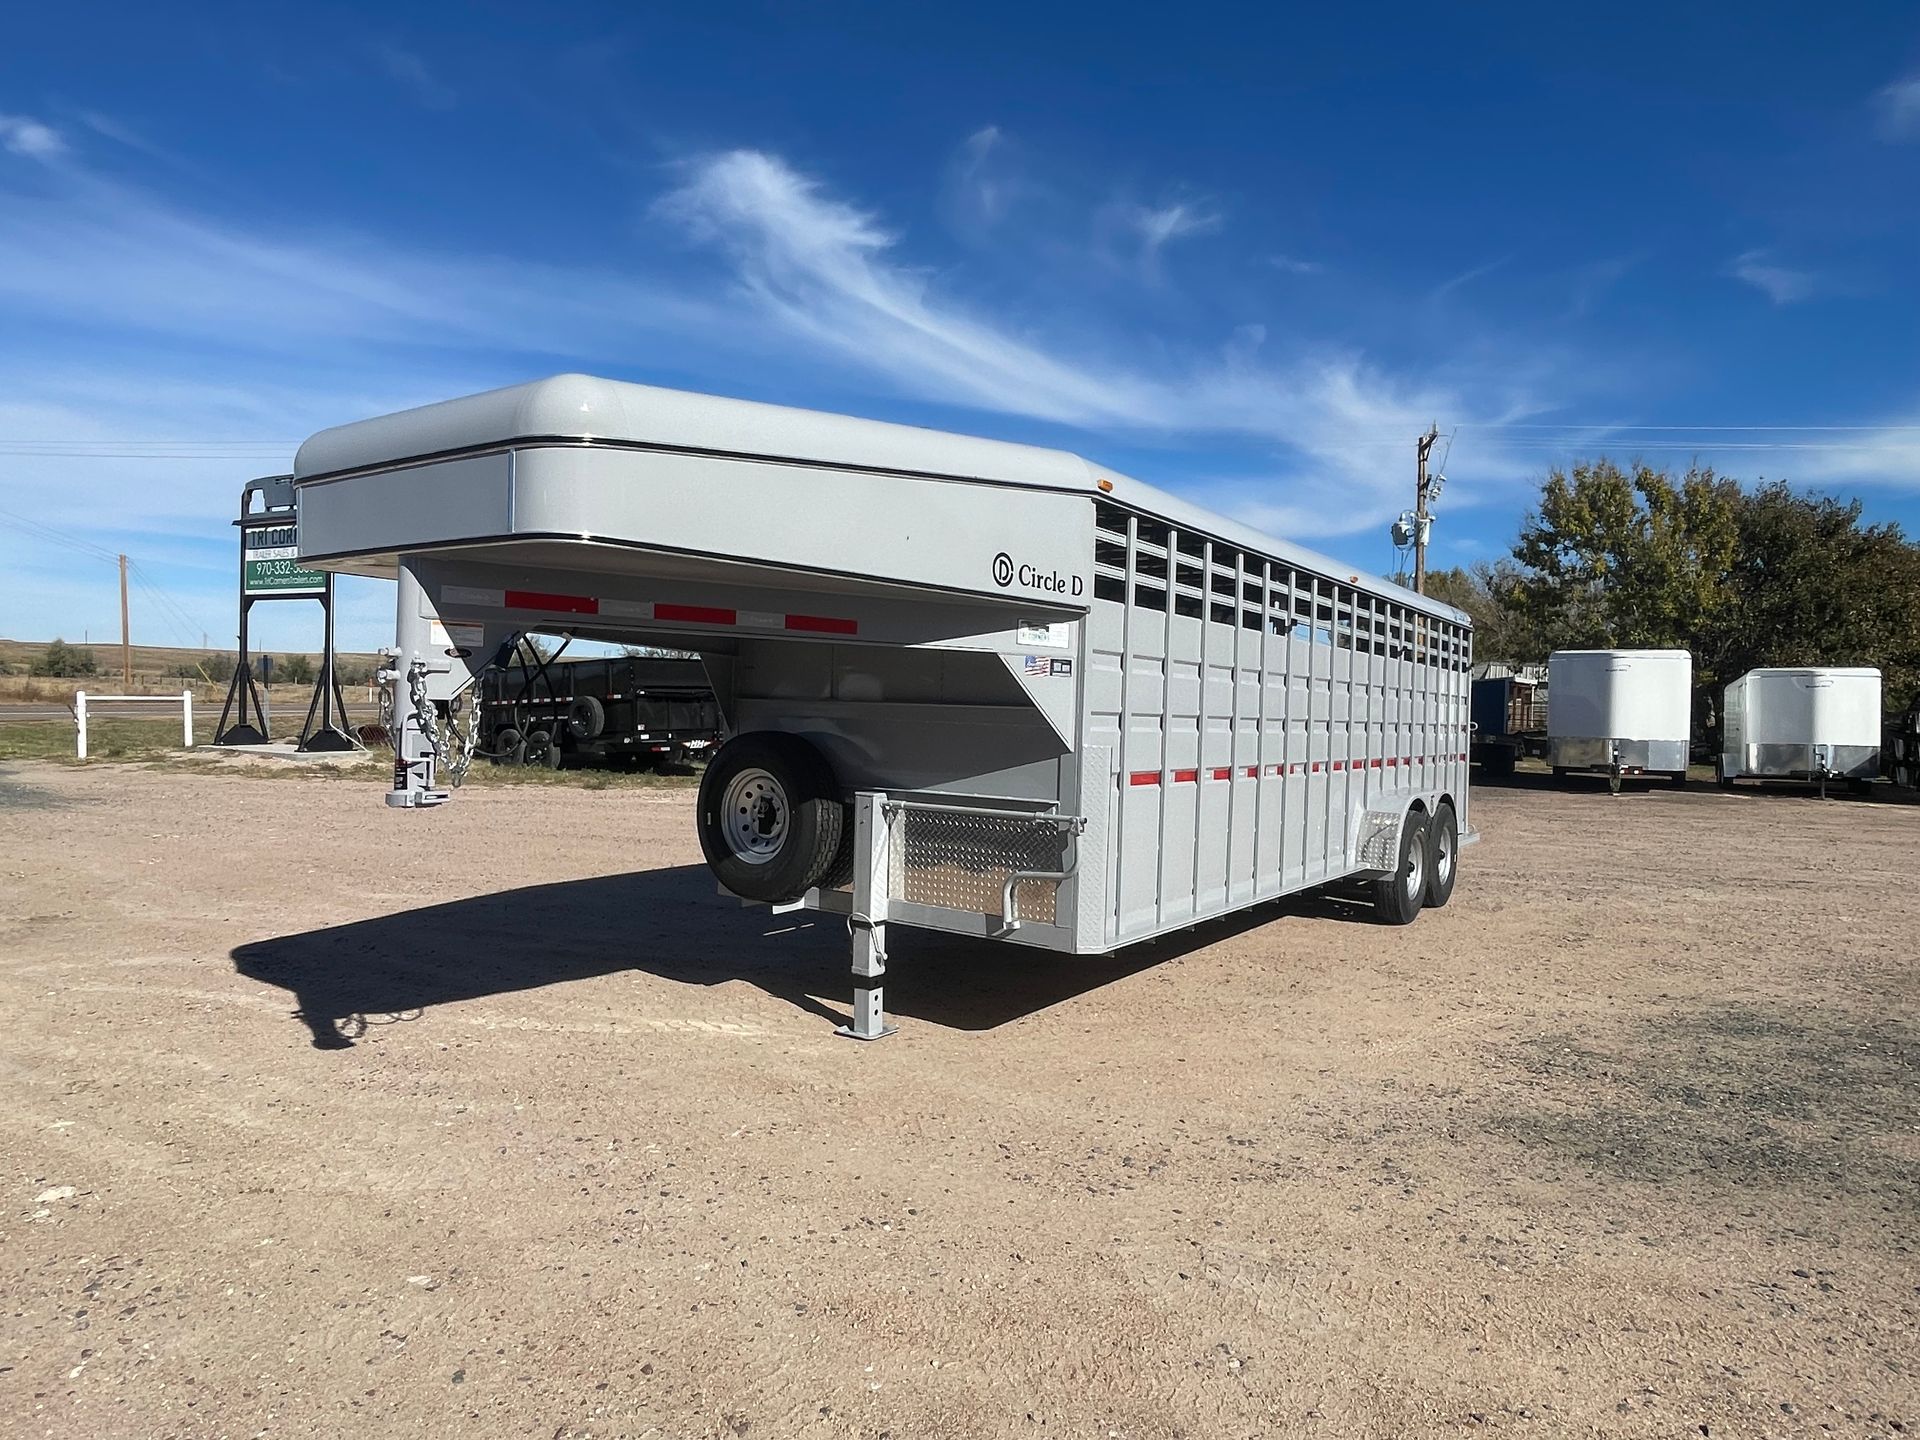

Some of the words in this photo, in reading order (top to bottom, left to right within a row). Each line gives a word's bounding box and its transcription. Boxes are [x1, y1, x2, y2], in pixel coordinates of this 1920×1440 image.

[250, 530, 268, 547] TRI
[1018, 564, 1066, 593] Circle
[1071, 575, 1083, 597] D
